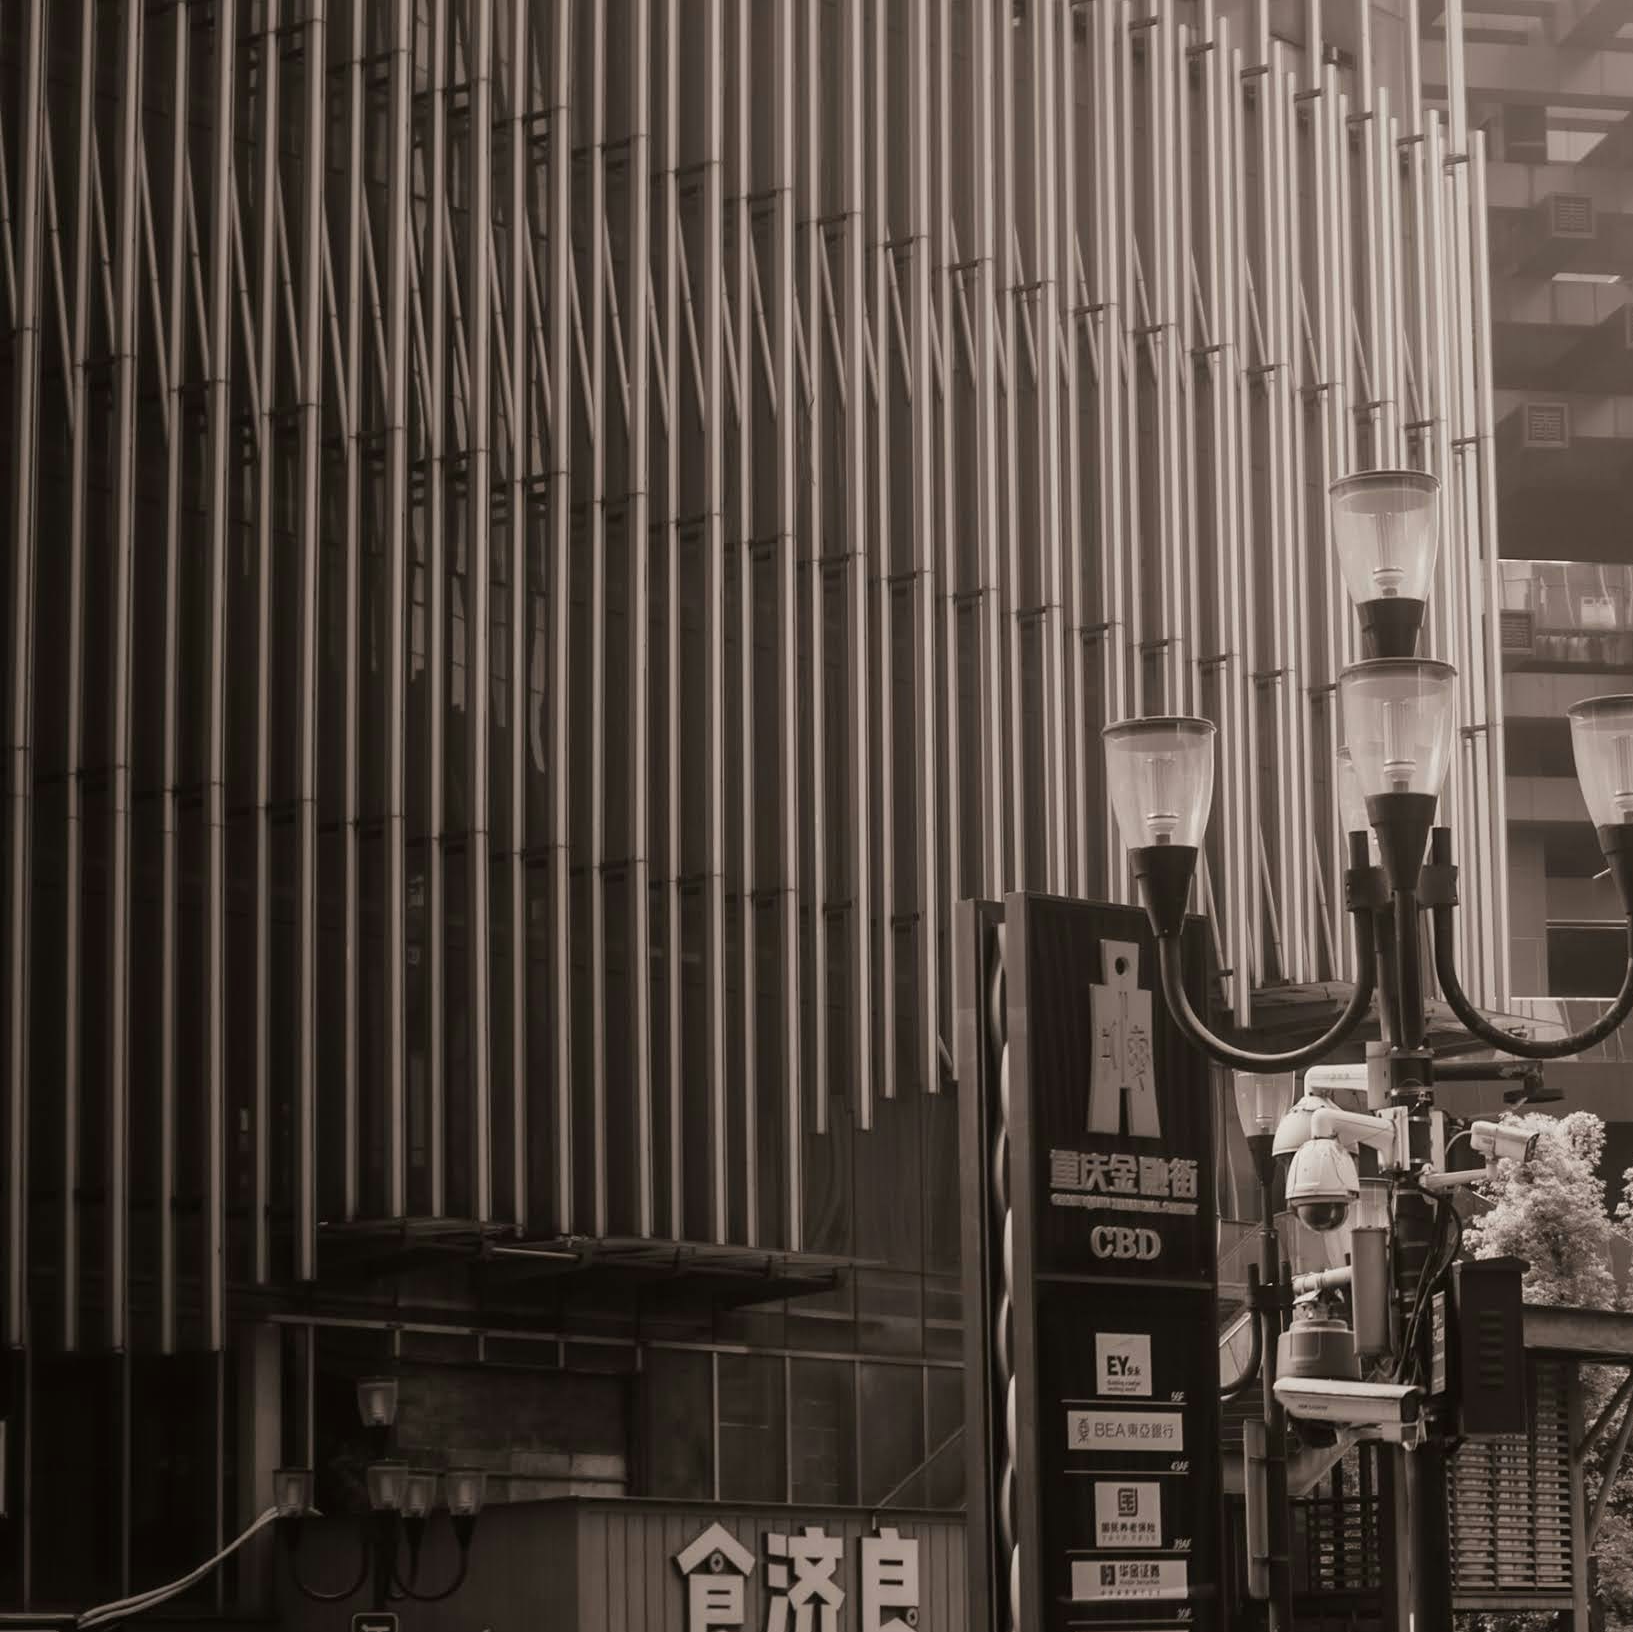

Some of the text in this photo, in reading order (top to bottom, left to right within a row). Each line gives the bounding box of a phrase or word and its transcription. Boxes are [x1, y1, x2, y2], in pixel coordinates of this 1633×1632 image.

[1049, 1149, 1198, 1199] 重庆金融街
[1090, 1225, 1161, 1260] CBD
